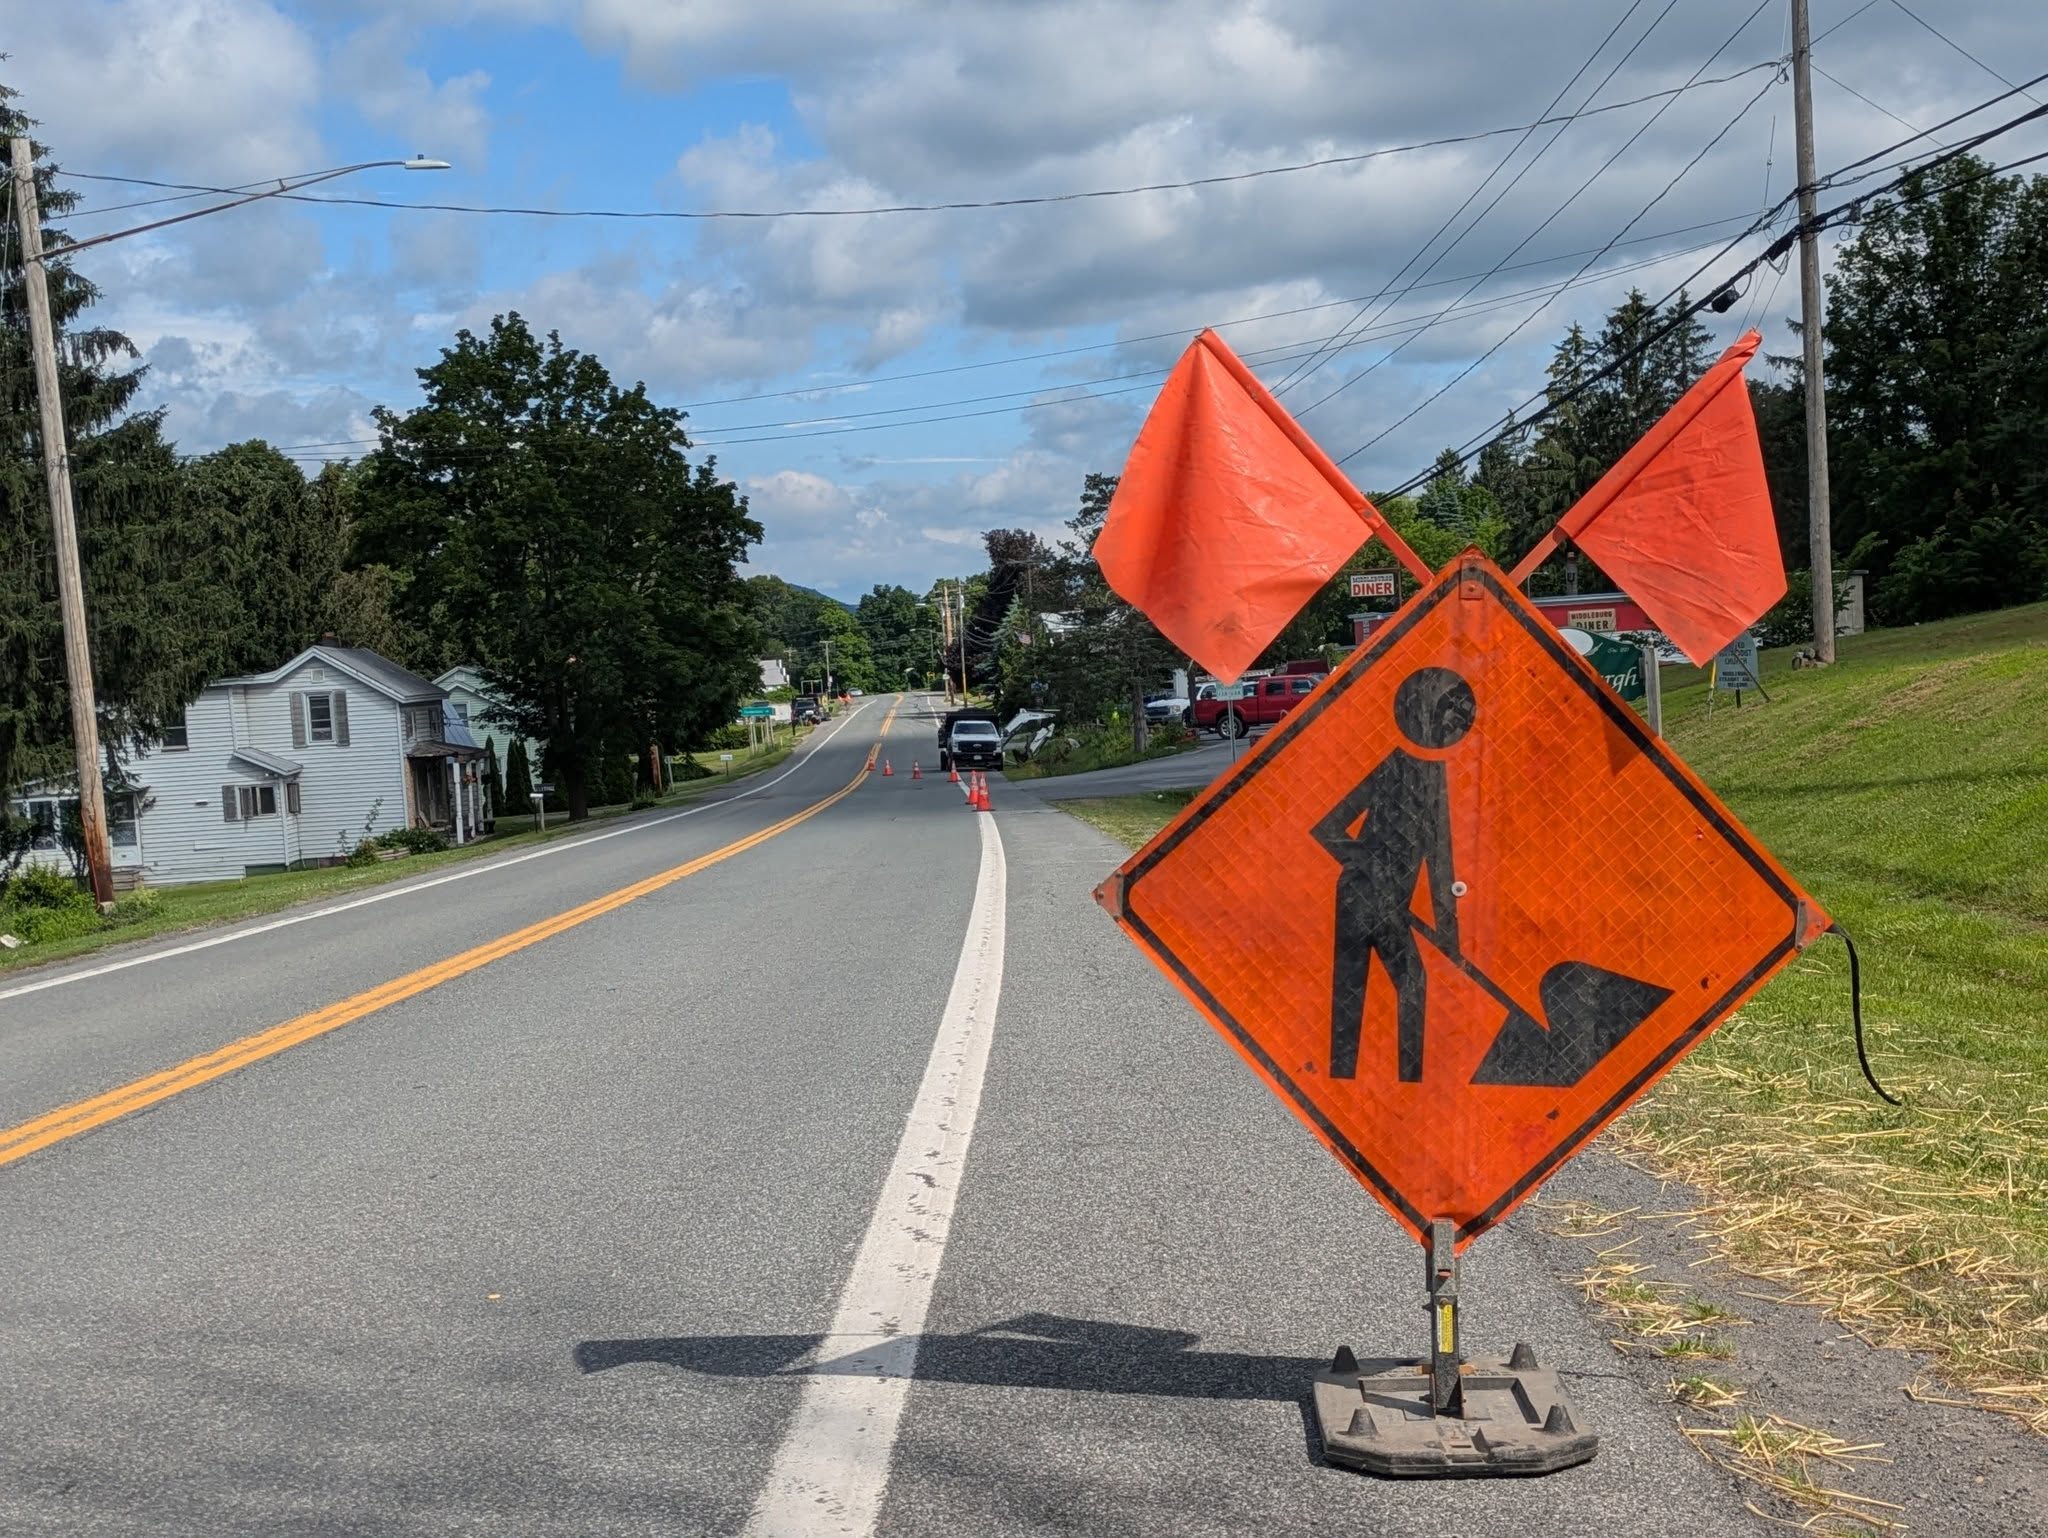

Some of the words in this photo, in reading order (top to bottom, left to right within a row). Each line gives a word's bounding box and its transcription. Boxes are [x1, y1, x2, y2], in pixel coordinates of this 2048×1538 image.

[1352, 582, 1393, 596] DINER
[1571, 610, 1613, 620] MIDDLEBURG
[1576, 620, 1609, 630] DINER
